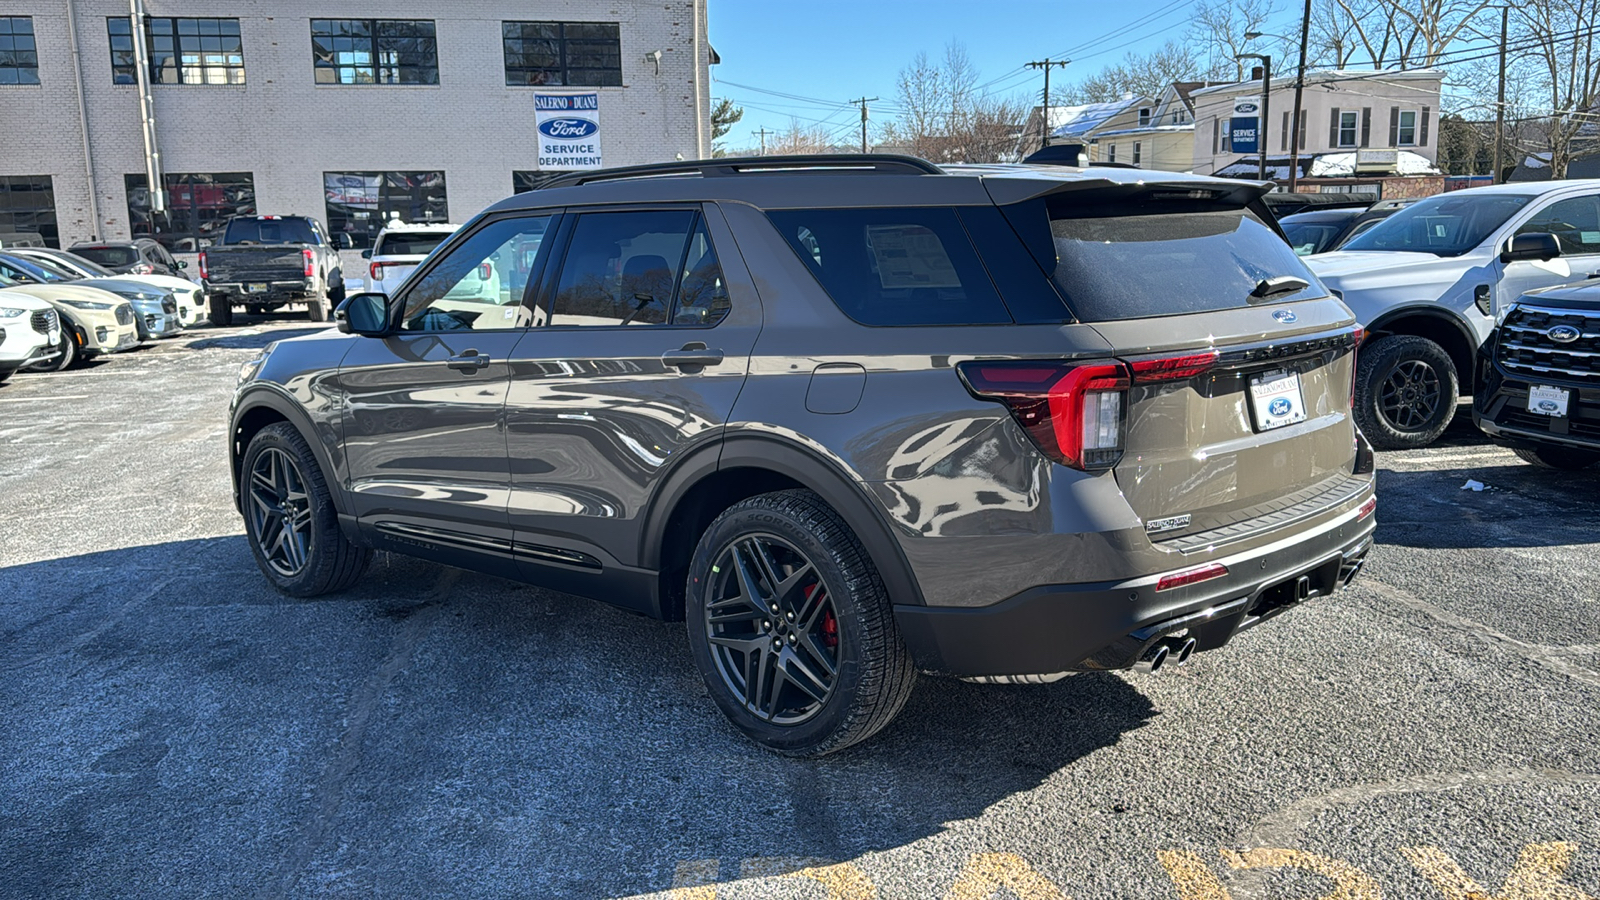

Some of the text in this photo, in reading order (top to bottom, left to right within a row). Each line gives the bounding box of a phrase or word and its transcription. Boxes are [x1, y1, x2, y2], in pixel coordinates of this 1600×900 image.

[535, 96, 597, 109] SALERNO DUANE
[550, 120, 587, 136] Ford
[1233, 129, 1256, 137] SERVICE
[545, 144, 594, 153] SERVICE
[539, 157, 601, 166] DEPARTMENT
[747, 513, 816, 547] SCORPION
